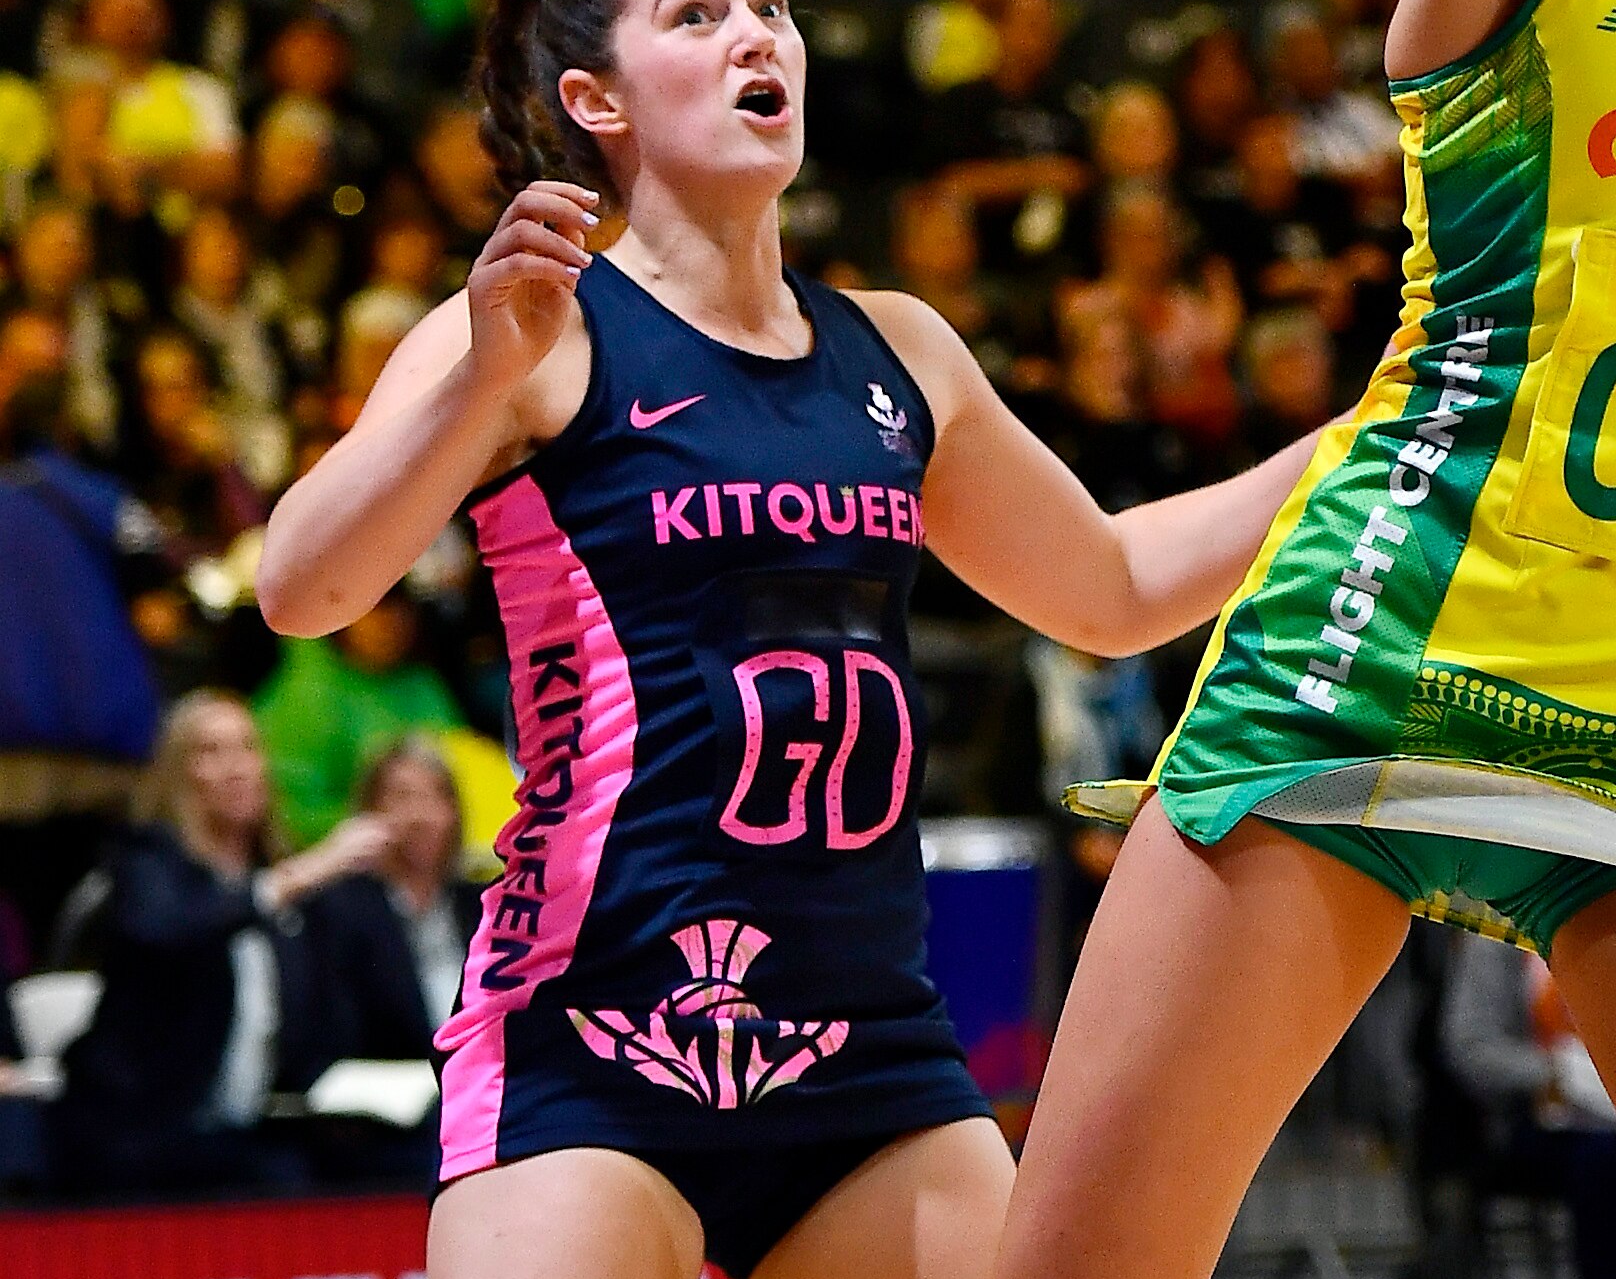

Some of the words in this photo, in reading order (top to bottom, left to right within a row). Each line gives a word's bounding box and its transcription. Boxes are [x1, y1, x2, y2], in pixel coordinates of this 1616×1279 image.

[651, 481, 924, 548] KITQUEEN
[1296, 505, 1408, 714] FLIGHT
[1389, 315, 1495, 507] CENTRE
[719, 649, 914, 851] GD
